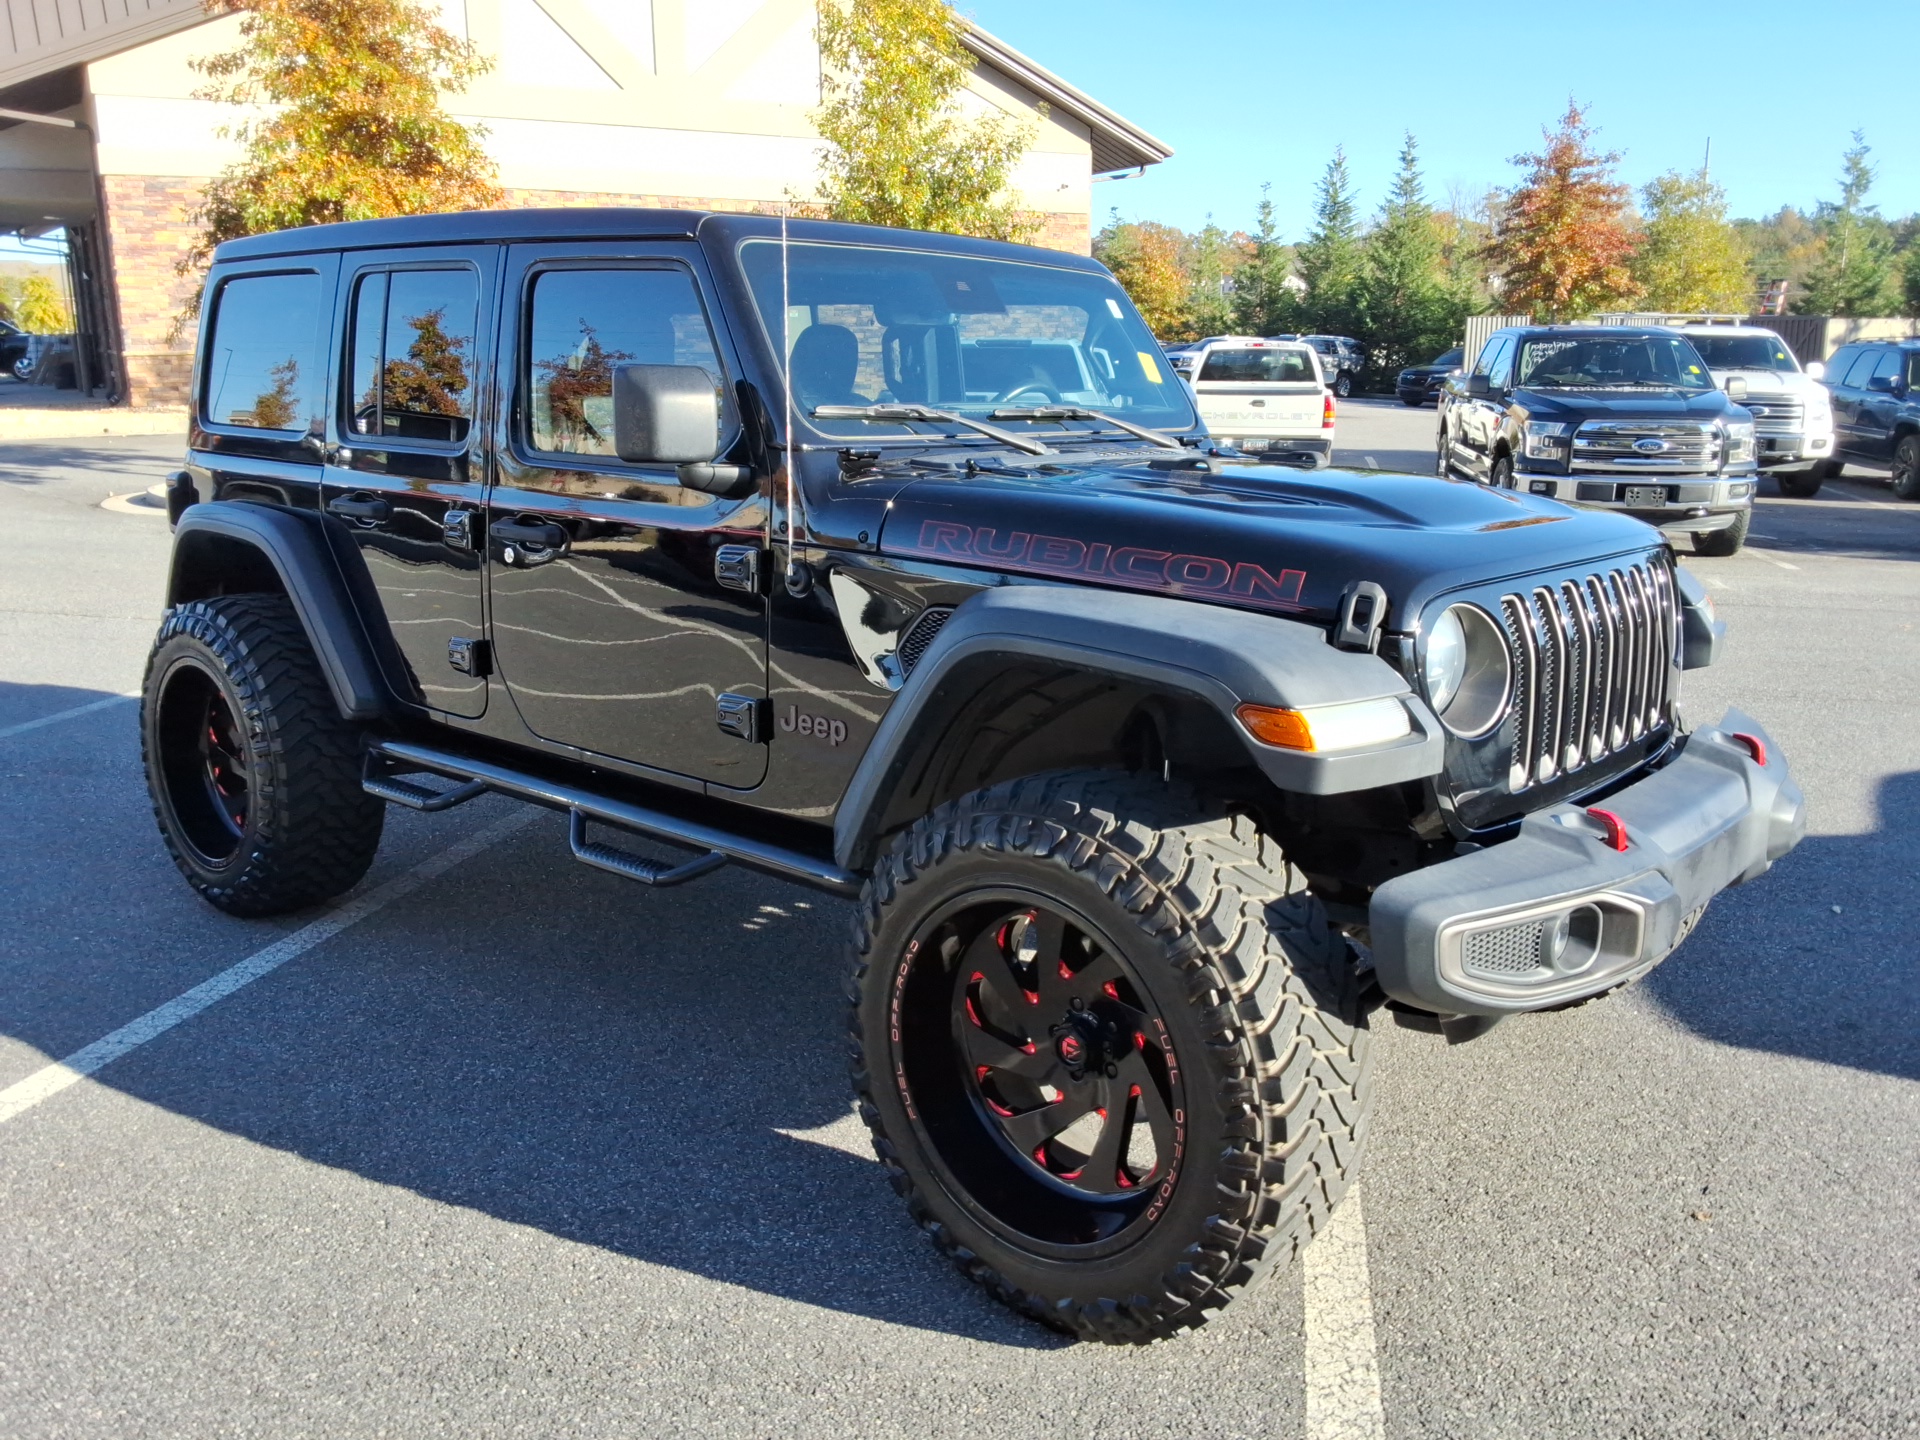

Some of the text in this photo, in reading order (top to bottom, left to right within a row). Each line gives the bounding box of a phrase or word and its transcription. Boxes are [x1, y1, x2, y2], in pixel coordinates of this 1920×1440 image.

[1201, 411, 1317, 421] CHEVROLET
[918, 519, 1307, 603] RUBICON
[780, 704, 848, 747] Jeep
[891, 939, 919, 1120] FUEL OFF-ROAD
[1146, 1017, 1185, 1221] FUEL OFF-ROAD
